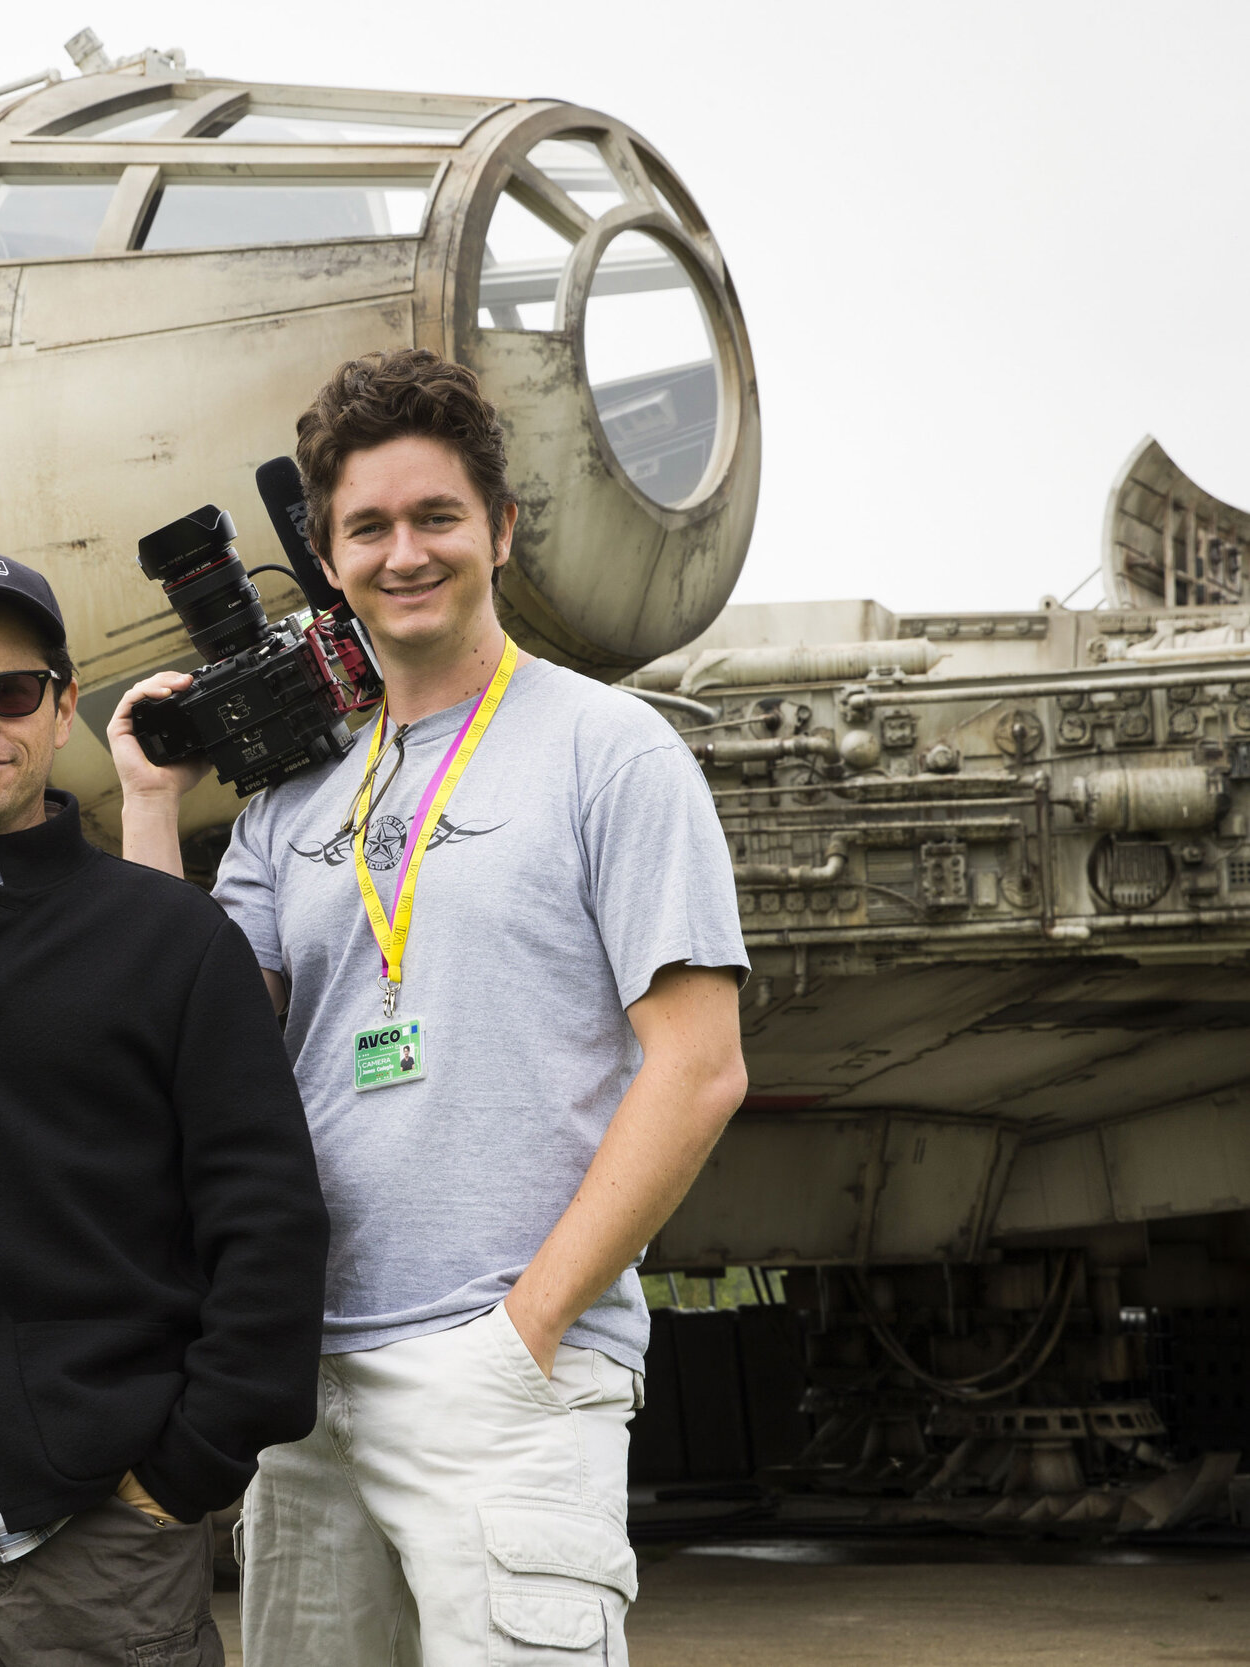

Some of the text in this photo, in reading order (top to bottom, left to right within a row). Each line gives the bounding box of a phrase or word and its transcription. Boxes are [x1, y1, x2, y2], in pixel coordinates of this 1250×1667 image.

[399, 892, 412, 913] VII
[393, 924, 407, 945] VII
[357, 1029, 401, 1051] AVCO
[362, 1057, 391, 1068] CAMERA
